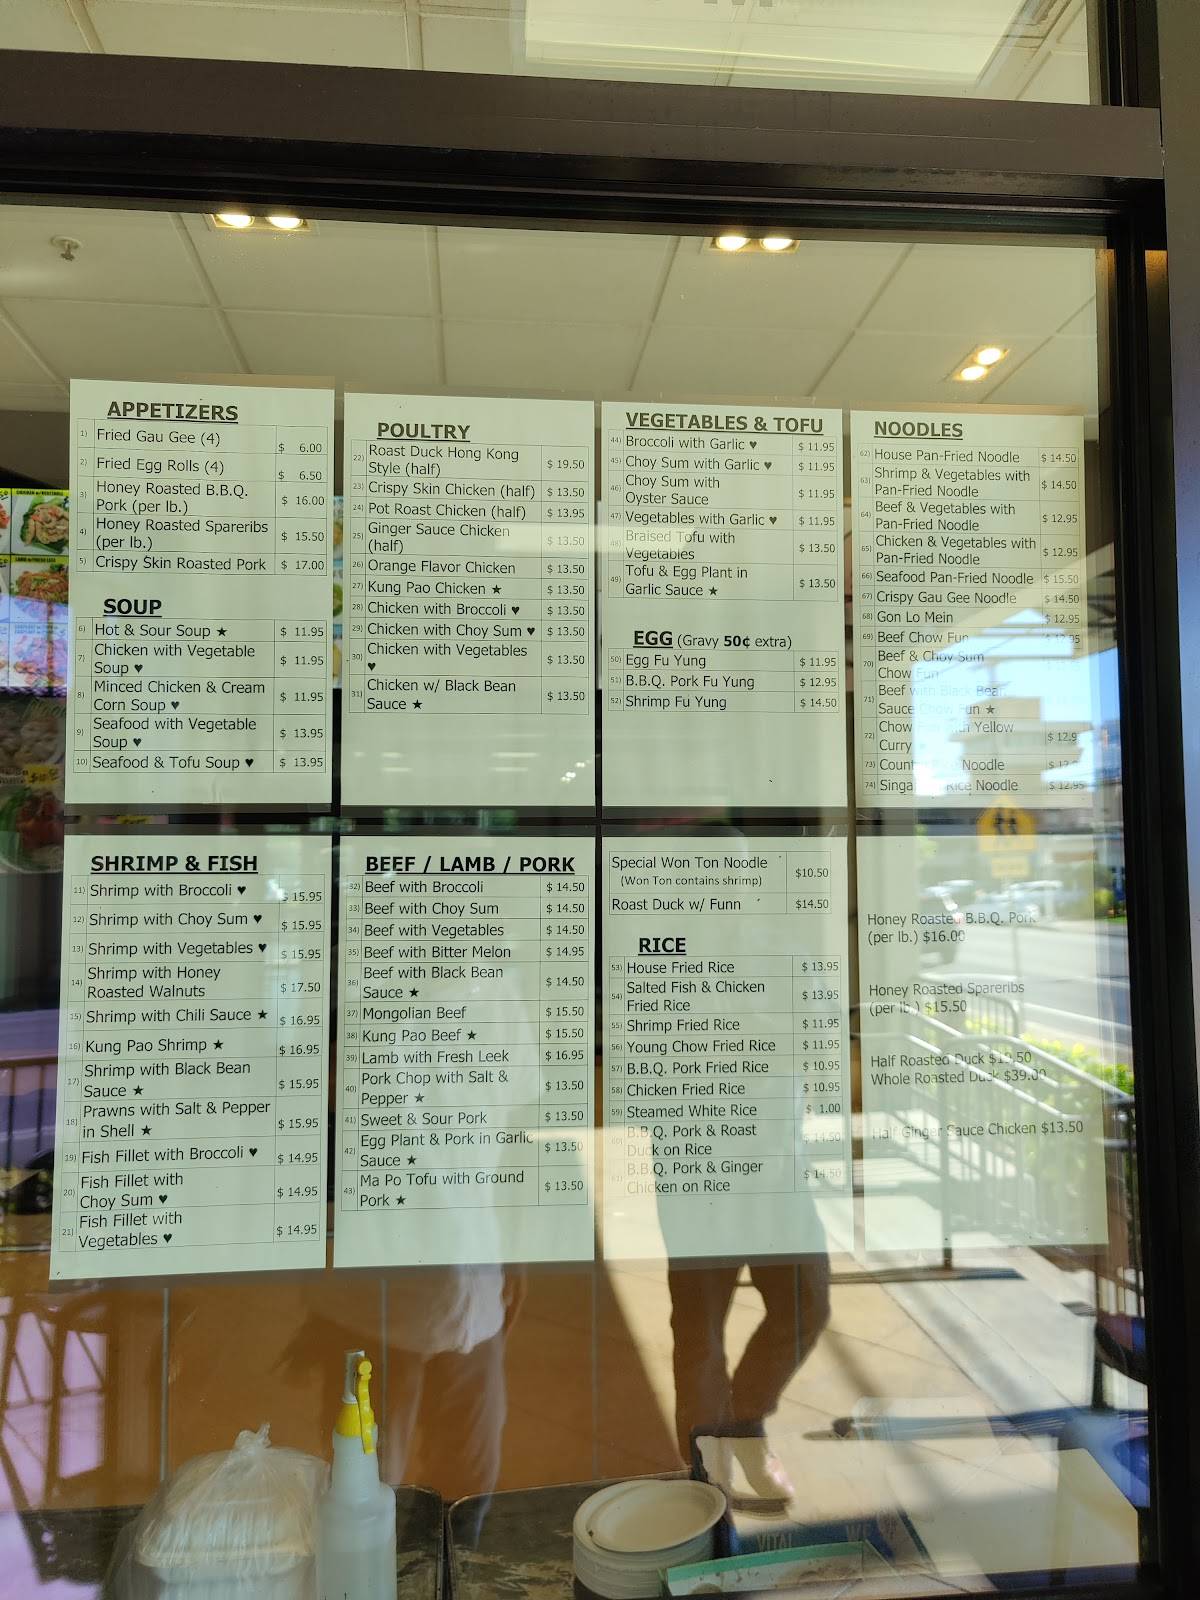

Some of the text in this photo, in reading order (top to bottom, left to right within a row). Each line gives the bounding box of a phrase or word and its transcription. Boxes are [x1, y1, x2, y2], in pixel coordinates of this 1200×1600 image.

[106, 401, 238, 422] APPETIZERS
[625, 411, 823, 433] VEGETABLES & TOFU
[873, 420, 963, 439] NOODLES
[97, 428, 220, 448] Fried Gau Gee (4)
[376, 422, 470, 441] POULTRY
[626, 435, 745, 450] Broccoli with Garlic
[369, 443, 519, 463] Roast Duck Hong Kong
[874, 448, 1020, 463] House Pan-Fried Noodle
[1050, 453, 1077, 463] 14.50
[368, 461, 441, 478] Style (half)
[557, 459, 585, 470] 19.50
[96, 480, 248, 499] Honey Roasted B.B.Q.
[296, 495, 325, 506] 16.00
[625, 491, 709, 506] Oyster Sauce
[96, 498, 188, 516] Pork (per lb.)
[875, 501, 1015, 516] Beef & Vegetables with
[79, 557, 87, 565] 5)
[95, 555, 266, 572] Crispy Skin Roasted Pork
[295, 560, 324, 570] 17.00
[352, 560, 364, 568] 26)
[367, 559, 515, 574] Orange Flavor Chicken
[557, 564, 585, 574] 13.50
[809, 578, 836, 589] 13.50
[876, 590, 1017, 605] Crispy Gau Gee Noodle
[102, 598, 162, 616] SOUP
[876, 610, 953, 623] Gon Lo Mein
[95, 623, 211, 640] Hot & Sour Soup
[295, 626, 324, 637] 11.95
[367, 622, 522, 639] Chicken with Choy Sum
[632, 630, 792, 650] EGG (Gravy 50¢ extra)
[94, 680, 265, 694] Minced Chicken & Cream
[626, 674, 754, 690] B.B.Q. Pork Fu Yung
[76, 758, 88, 766] 10)
[92, 755, 240, 771] Seafood & Tofu Soup
[90, 855, 258, 873] SHRIMP & FISH
[366, 855, 575, 873] BEEF / LAMB / PORK
[611, 856, 768, 871] Special Won Ton Noodle
[620, 875, 762, 887] (Won Ton contains shrimp)
[795, 868, 829, 879] $10.50
[72, 915, 85, 924] 12)
[89, 912, 248, 928] Shrimp with Choy Sum
[292, 920, 322, 932] 15.95
[867, 930, 894, 945] (per
[898, 929, 918, 945] lb.)
[364, 945, 511, 959] Beef with Bitter Melon
[556, 946, 584, 956] 14.95
[639, 937, 686, 953] RICE
[611, 964, 623, 972] 53)
[87, 984, 205, 999] Roasted Walnuts
[869, 982, 1024, 998] Honey Roasted Spareribs
[85, 1038, 207, 1055] Kung Pao Shrimp
[362, 1049, 509, 1065] Lamb with Fresh Leek
[870, 1072, 910, 1086] Whole
[914, 1070, 965, 1084] Roasted
[626, 1103, 757, 1118] Steamed White Rice
[360, 1111, 487, 1127] Sweet & Sour Pork
[82, 1145, 244, 1164] Fish Fillet with Broccoli
